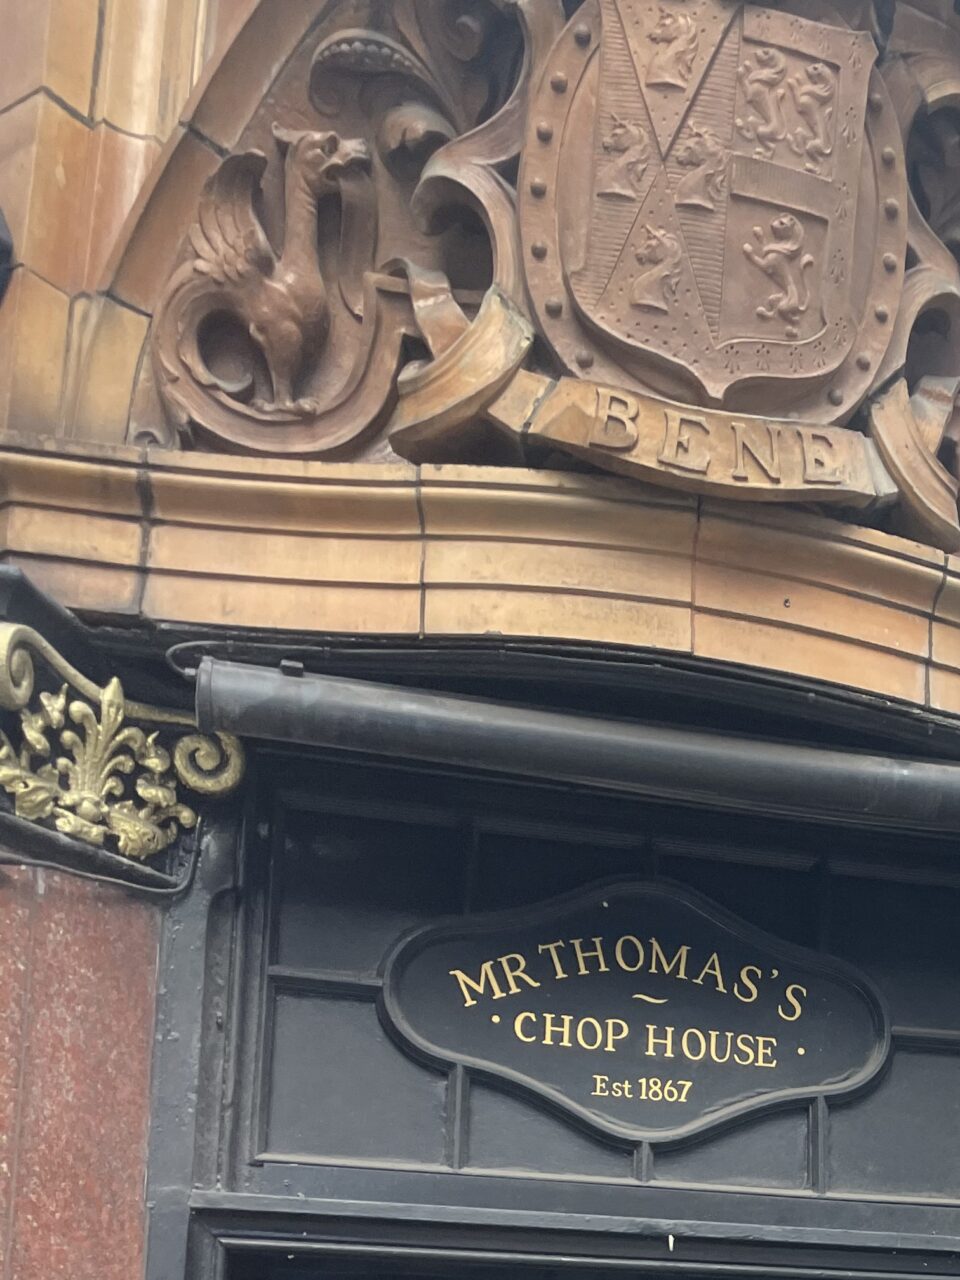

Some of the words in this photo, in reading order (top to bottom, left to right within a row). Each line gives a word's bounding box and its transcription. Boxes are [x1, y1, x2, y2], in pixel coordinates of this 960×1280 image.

[586, 386, 852, 487] BENE
[449, 953, 540, 1008] MR
[538, 935, 807, 1022] THOMAS'S
[514, 1011, 629, 1052] CHOP
[644, 1024, 778, 1069] HOUSE
[591, 1075, 633, 1098] Est
[638, 1078, 693, 1103] 1867
